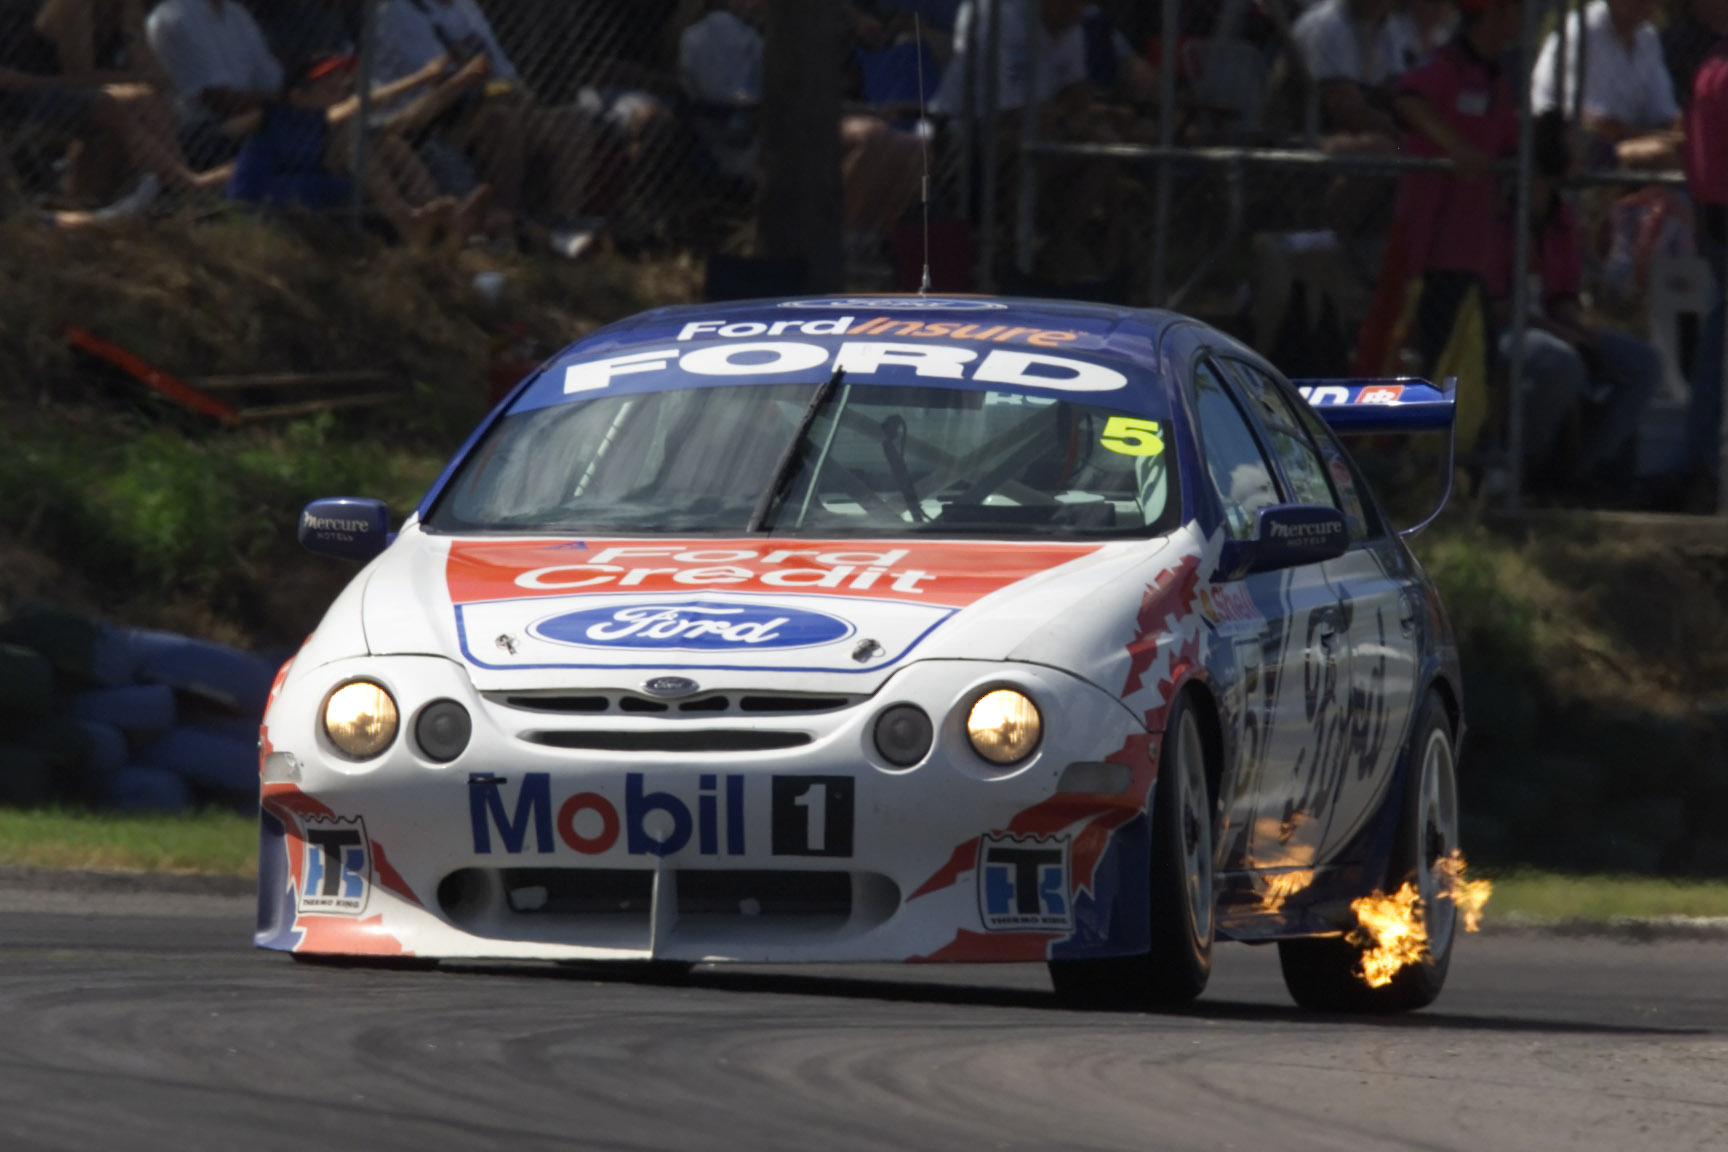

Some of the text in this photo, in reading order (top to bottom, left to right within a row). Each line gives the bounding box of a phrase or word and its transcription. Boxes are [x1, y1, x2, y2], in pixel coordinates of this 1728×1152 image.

[563, 340, 1128, 395] FORD
[1100, 416, 1165, 457] 5
[586, 546, 911, 568] Ford
[513, 564, 938, 594] Credit
[585, 603, 792, 643] Ford
[468, 772, 828, 858] Mobil 1
